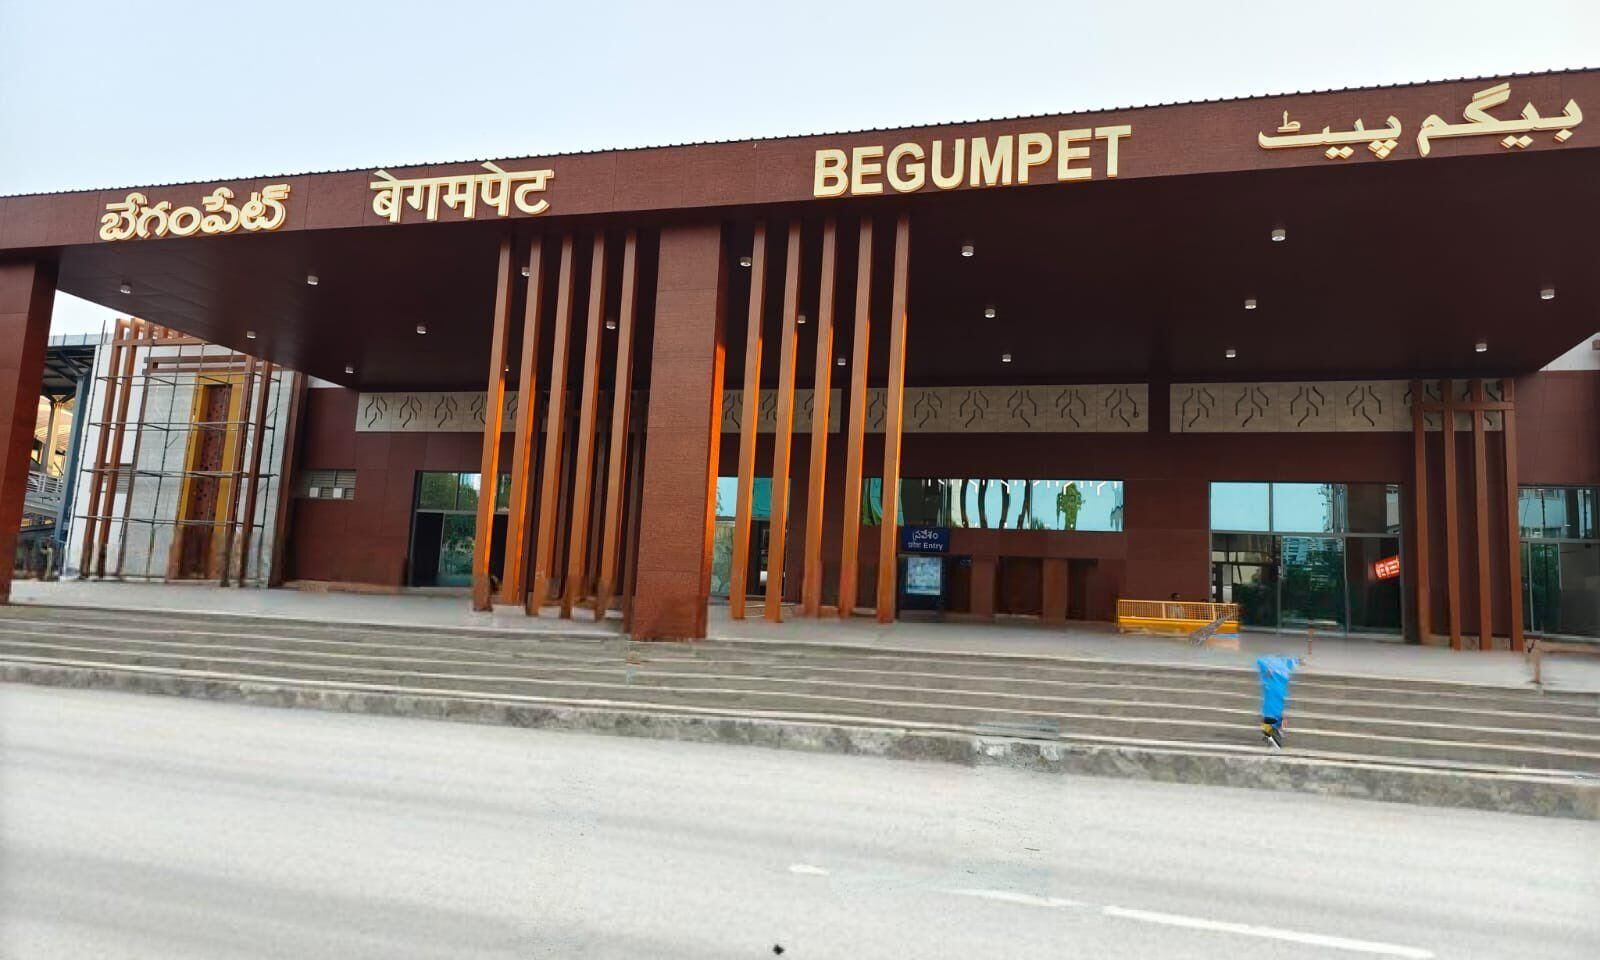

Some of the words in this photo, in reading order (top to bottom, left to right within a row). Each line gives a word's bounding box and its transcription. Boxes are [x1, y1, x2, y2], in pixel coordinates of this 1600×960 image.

[369, 160, 554, 223] बेगमपेट
[813, 125, 1132, 198] BEGUMPET
[99, 184, 291, 241] బేగంపేట్
[923, 542, 944, 551] Entry
